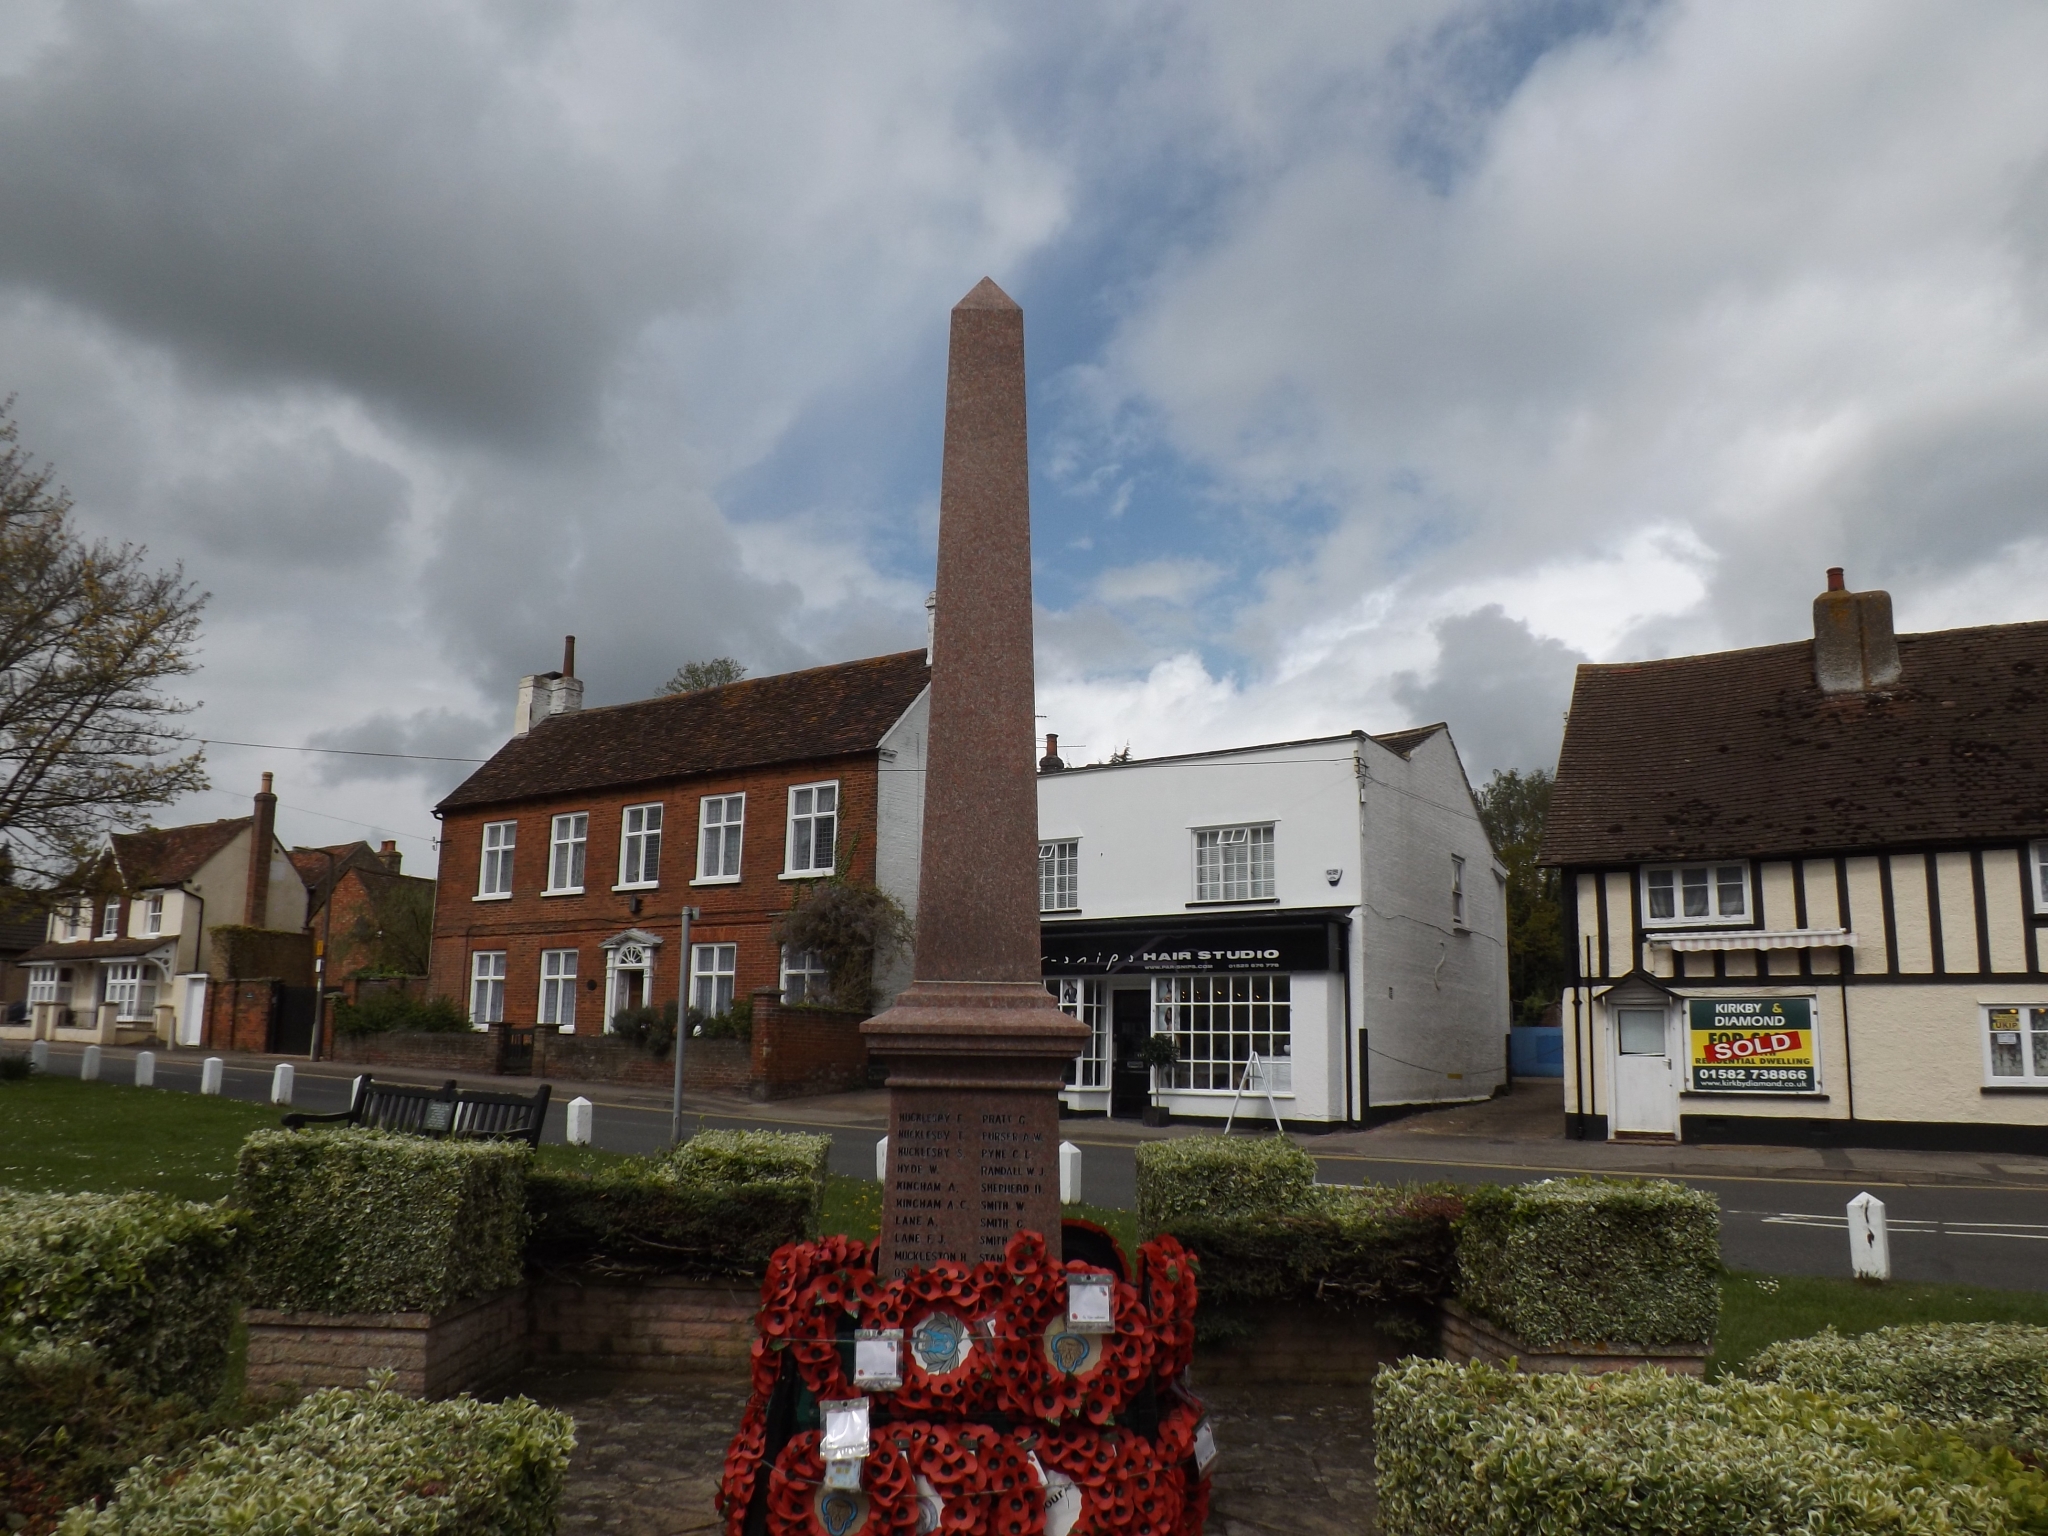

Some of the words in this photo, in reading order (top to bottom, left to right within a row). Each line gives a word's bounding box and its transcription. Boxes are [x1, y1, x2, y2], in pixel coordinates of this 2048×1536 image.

[1143, 951, 1192, 961] HAIR
[1197, 949, 1280, 960] STUDIO
[1715, 1003, 1762, 1014] KIRKBY
[1772, 1002, 1783, 1013] &
[1714, 1016, 1786, 1027] DIAMOND
[1714, 1034, 1791, 1060] SOLD
[1699, 1069, 1746, 1079] 01582
[1750, 1069, 1808, 1080] 738866
[1700, 1080, 1808, 1088] www.kirkbydiamond.co.uk
[982, 1114, 1012, 1124] PRATT
[898, 1129, 950, 1140] HUCKLESBY
[982, 1131, 1018, 1142] PURSER
[897, 1146, 950, 1158] HUCKLESBY
[981, 1148, 1006, 1159] PYNE
[897, 1163, 922, 1174] HYDE
[980, 1166, 1022, 1176] RANDALL
[981, 1183, 1029, 1194] SHEPHERD
[980, 1200, 1009, 1211] SMITH
[895, 1215, 922, 1226] LANE
[980, 1218, 1009, 1229] SMITH
[895, 1232, 920, 1243] LANE
[979, 1235, 1008, 1246] SMITH
[894, 1250, 956, 1262] MUCKLESTON
